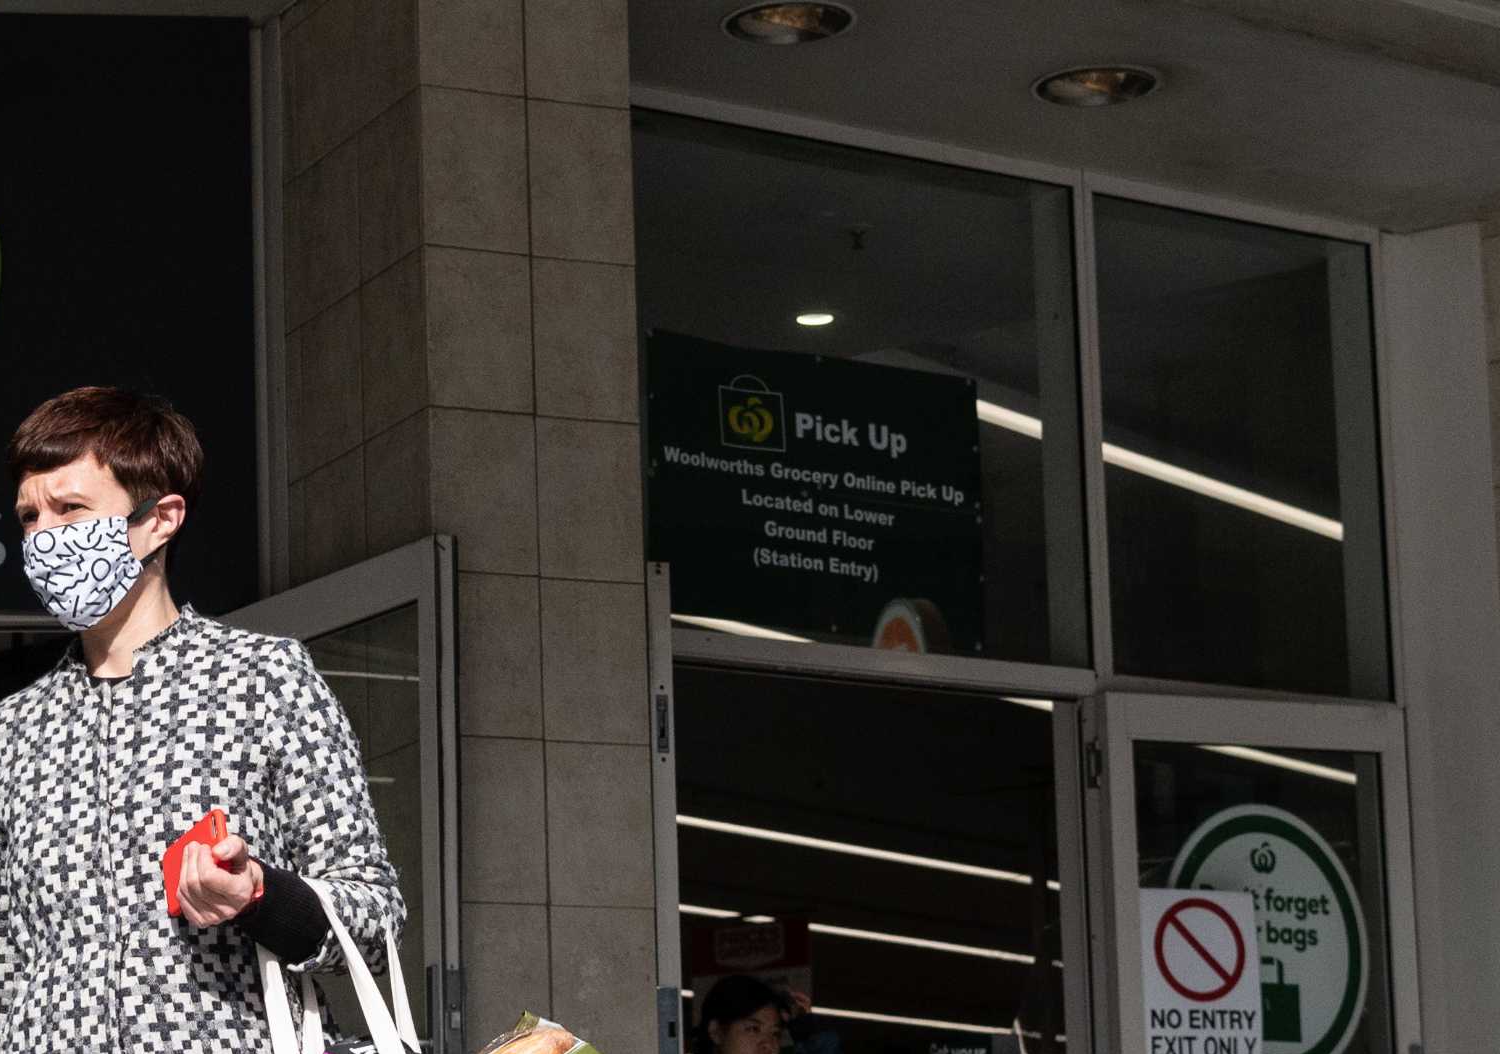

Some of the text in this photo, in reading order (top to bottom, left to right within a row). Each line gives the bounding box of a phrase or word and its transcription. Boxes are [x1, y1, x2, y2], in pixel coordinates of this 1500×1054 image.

[795, 412, 908, 458] Pick Up
[663, 445, 966, 507] Woolworths Grocery Online Pick Up
[741, 488, 896, 527] Located on Lower
[763, 519, 876, 552] Ground Floor
[753, 546, 880, 584] (Station Entry)
[1266, 888, 1330, 920] forget
[1267, 920, 1318, 953] bags
[1151, 1009, 1256, 1030] NO ENTRY
